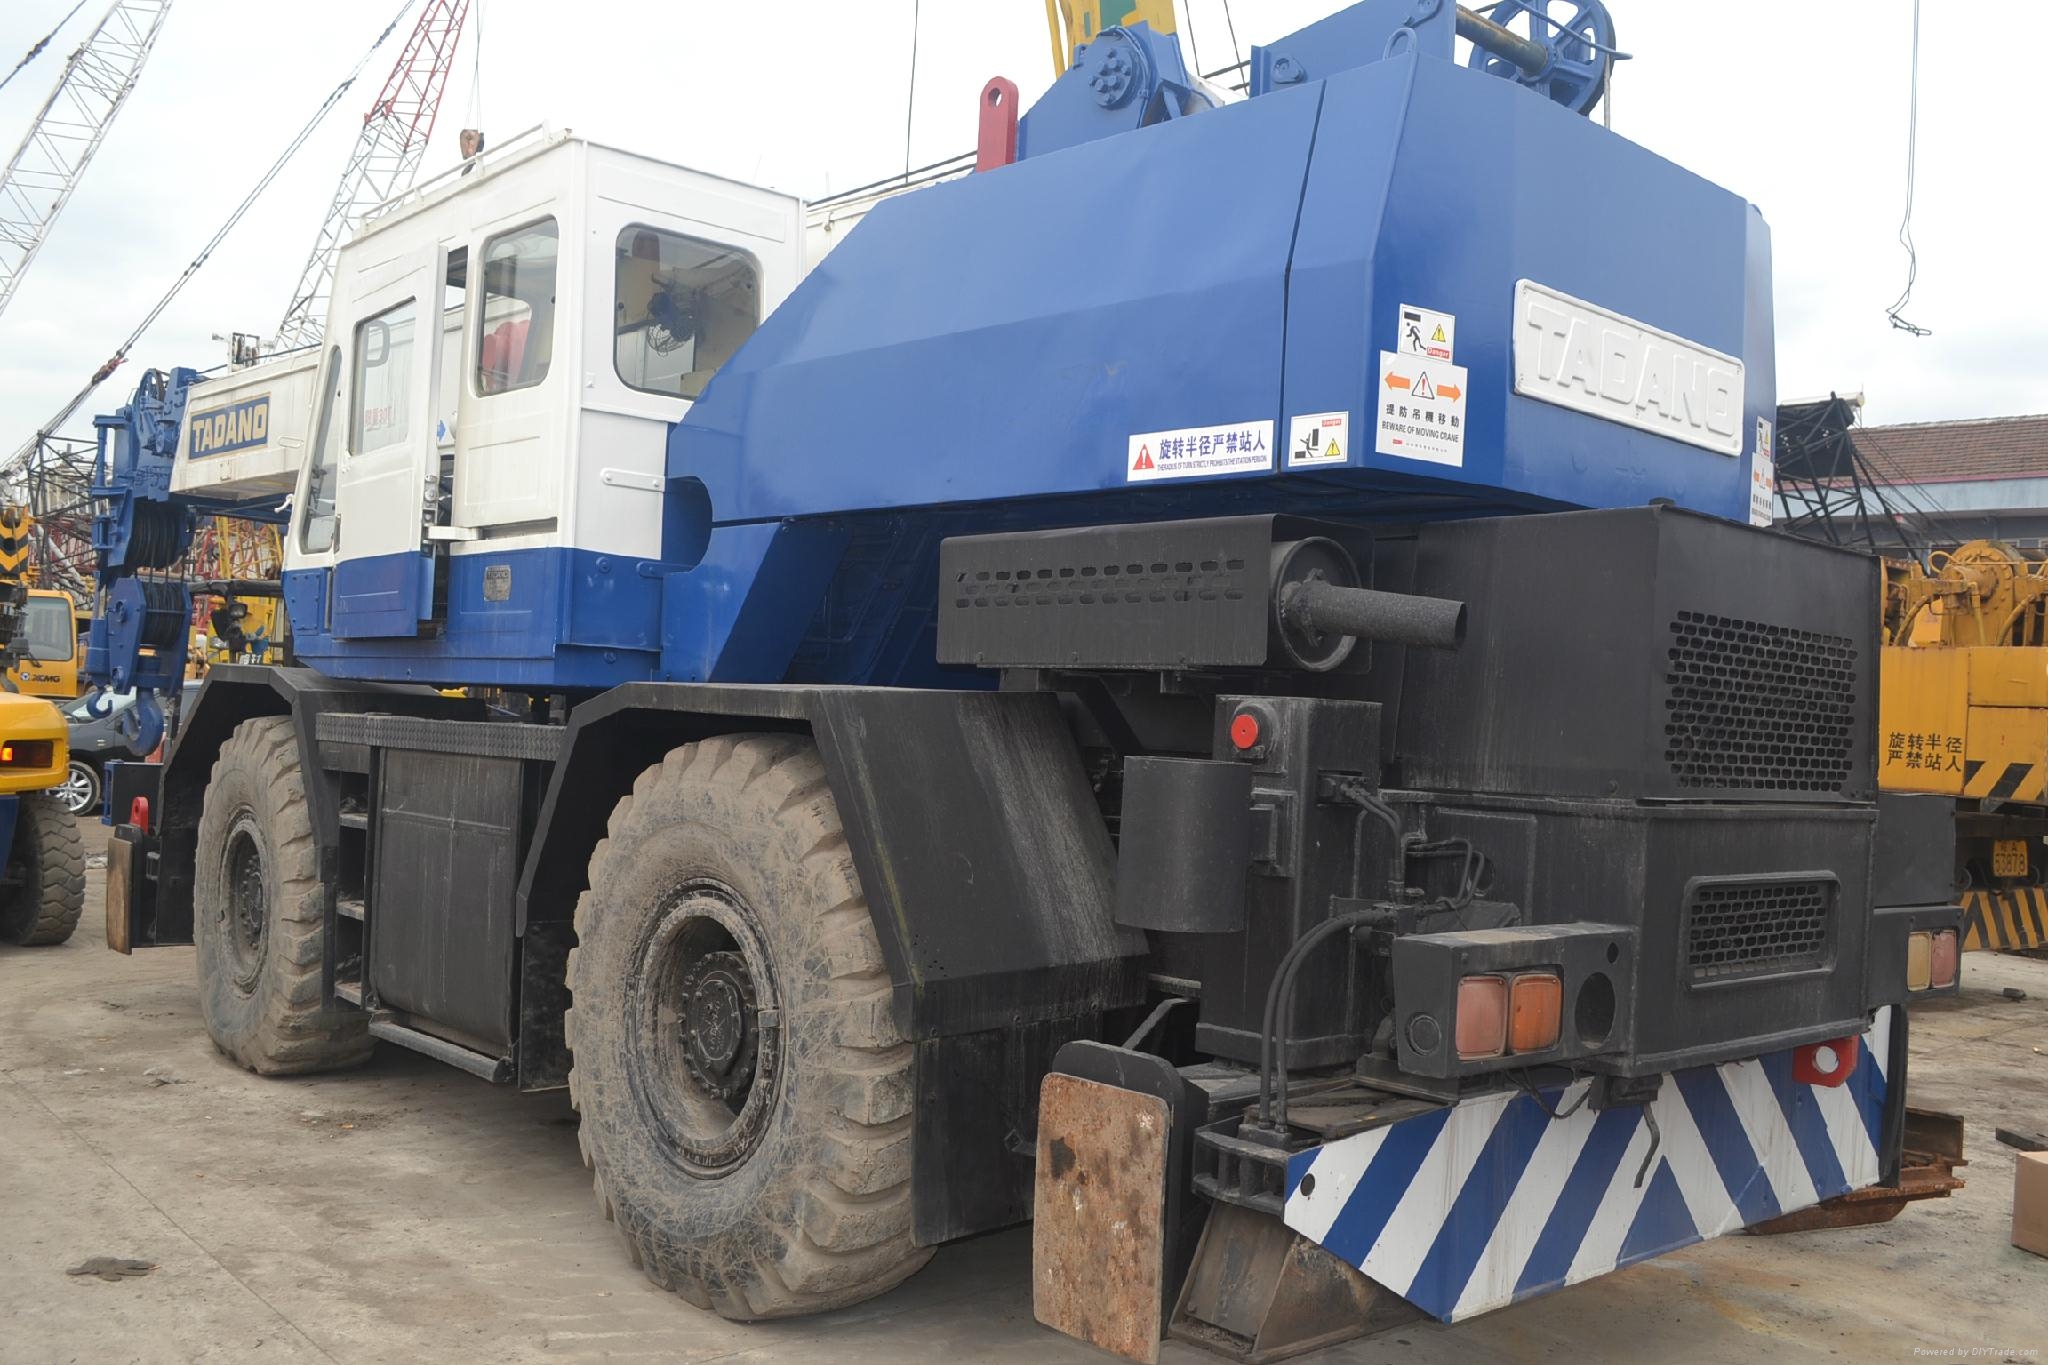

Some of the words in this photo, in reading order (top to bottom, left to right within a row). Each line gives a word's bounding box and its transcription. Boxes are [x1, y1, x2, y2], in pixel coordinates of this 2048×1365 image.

[1427, 347, 1450, 358] Danger
[1527, 301, 1735, 437] TADANO
[193, 404, 268, 452] TADANO
[1382, 420, 1406, 433] BEWARE
[1407, 425, 1415, 434] OF
[1416, 427, 1439, 439] MOVING
[1440, 431, 1459, 443] CRANE
[1159, 429, 1266, 460] 旋转半径严禁站人
[1888, 732, 1963, 754] 旋转半径
[1886, 749, 1962, 772] 严禁站人
